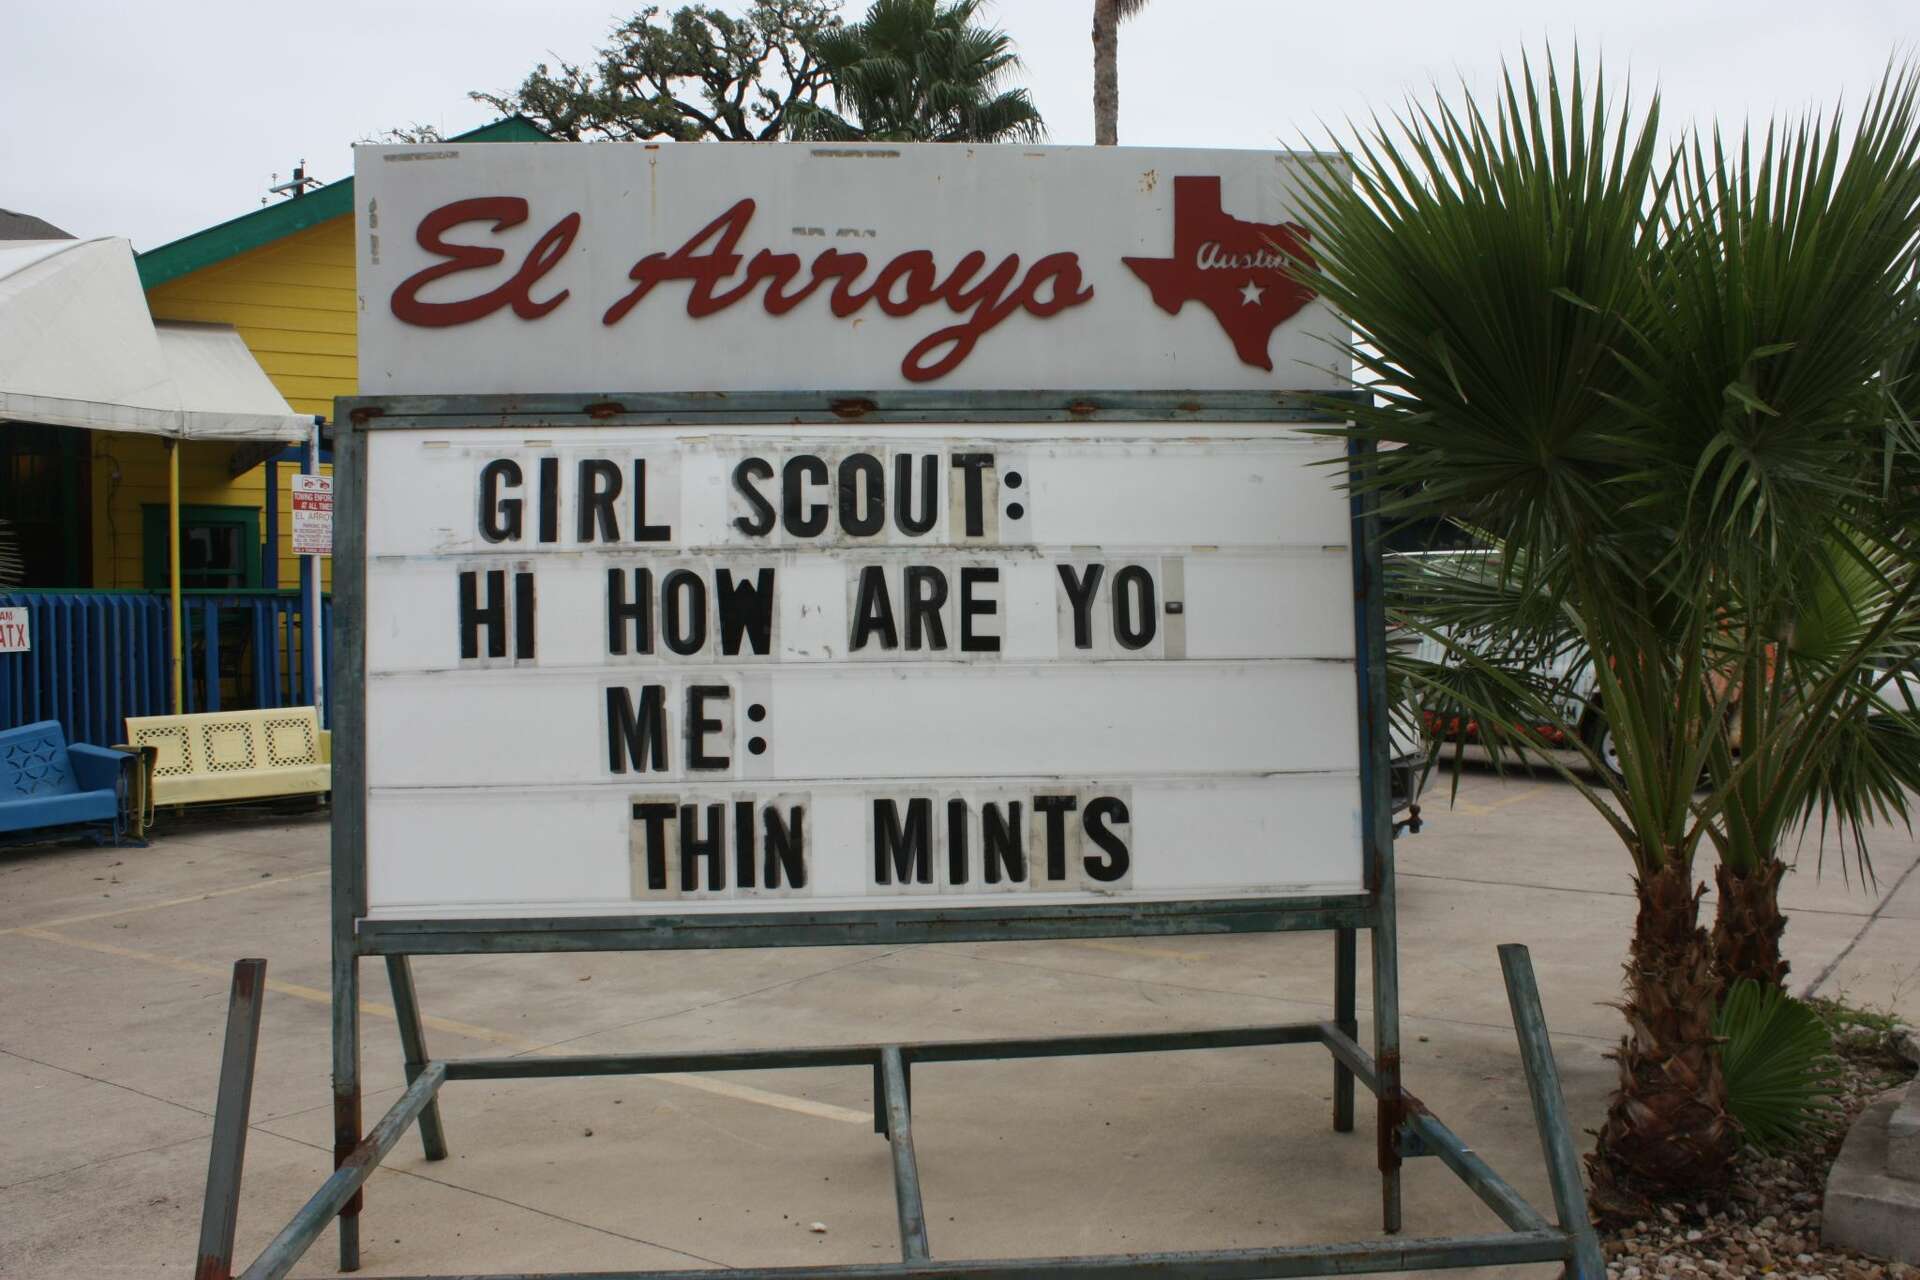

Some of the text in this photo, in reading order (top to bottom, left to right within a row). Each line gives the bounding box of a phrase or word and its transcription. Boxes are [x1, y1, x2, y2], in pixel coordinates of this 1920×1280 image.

[391, 196, 1094, 382] El Arroyo
[1196, 241, 1290, 270] Austin
[479, 452, 1024, 544] GIRL SCOUT:
[459, 562, 1184, 660] HI HOW ARE YO-
[606, 684, 768, 775] ME:
[631, 795, 1131, 893] THIN MINTS
